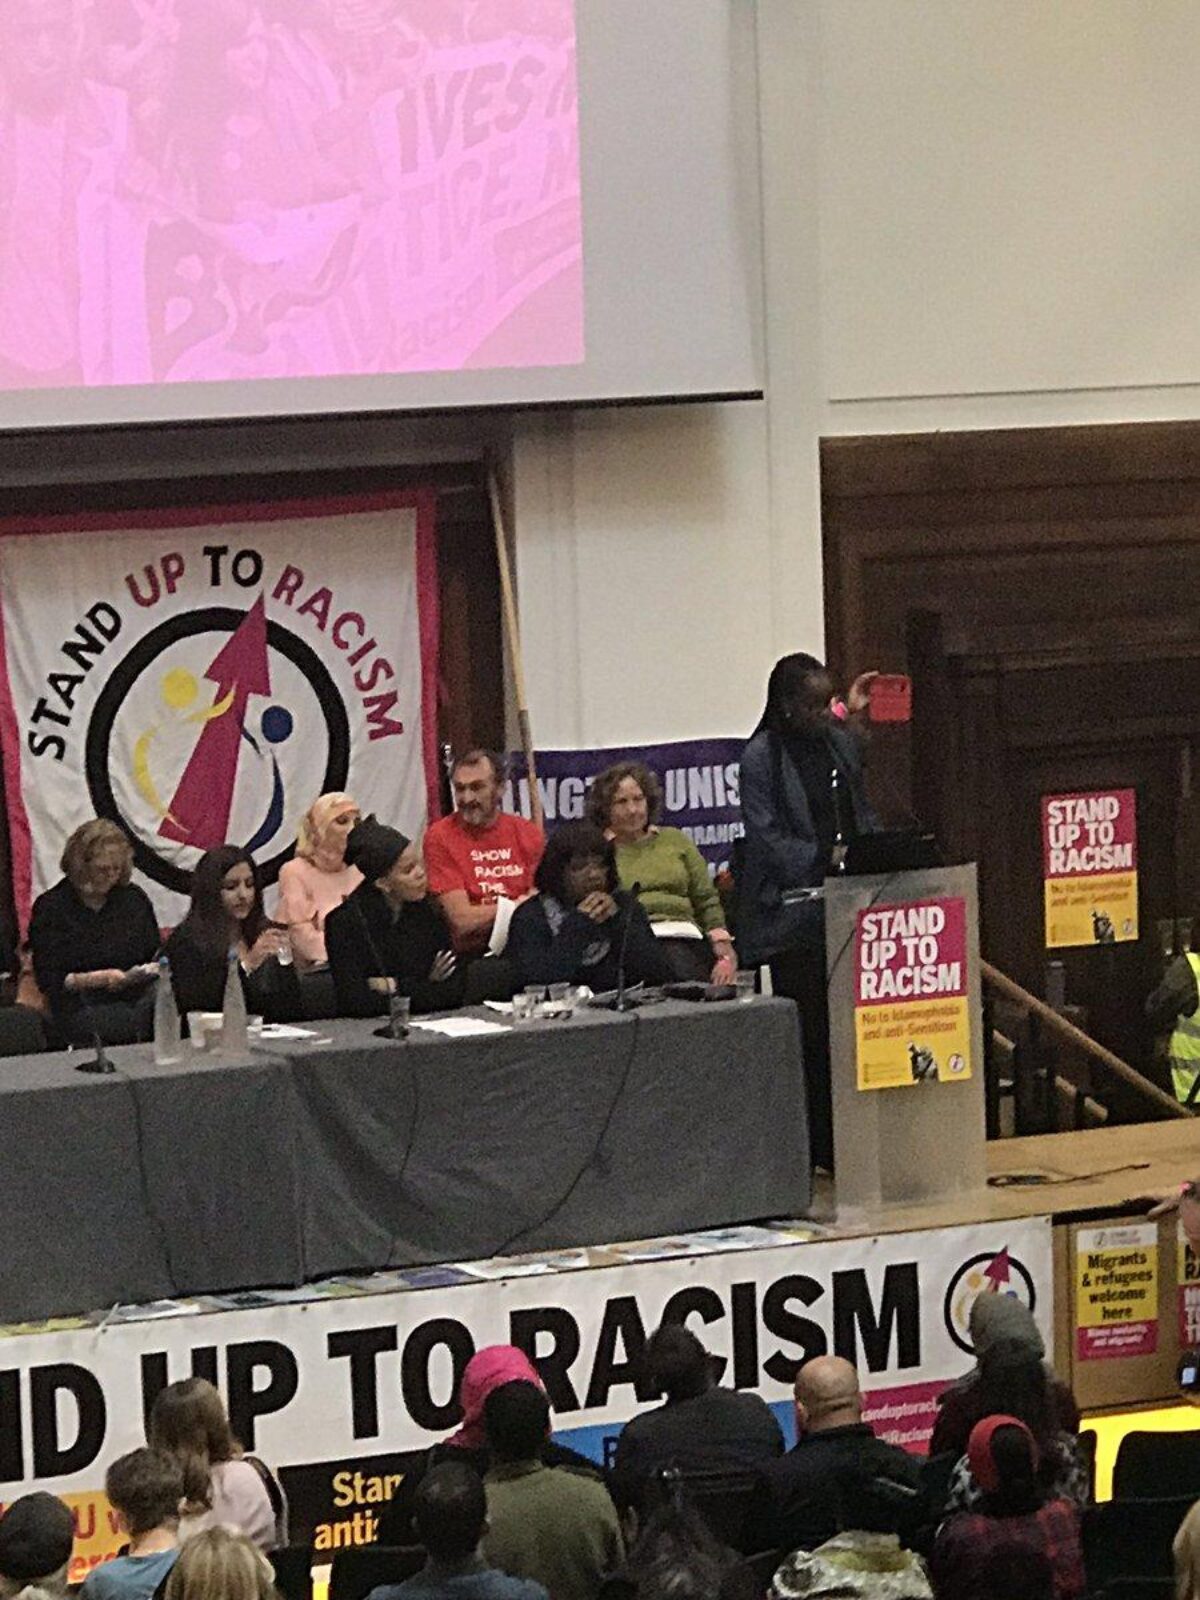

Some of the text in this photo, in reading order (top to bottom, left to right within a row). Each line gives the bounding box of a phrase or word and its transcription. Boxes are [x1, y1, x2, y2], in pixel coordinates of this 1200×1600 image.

[27, 545, 404, 761] STAND UP TO RACISM
[1047, 796, 1120, 825] STAND
[1049, 820, 1115, 849] UP TO
[470, 848, 511, 861] SHOW
[1049, 843, 1133, 874] RACISM
[861, 905, 945, 942] STAND
[860, 935, 939, 971] UP TO
[860, 961, 962, 1001] RACISM
[1088, 1252, 1147, 1271] Migrants
[1082, 1270, 1153, 1287] & refugees
[1089, 1289, 1146, 1304] welcome
[1102, 1306, 1133, 1320] here
[327, 1317, 477, 1440] TO
[509, 1261, 921, 1412] RACISM
